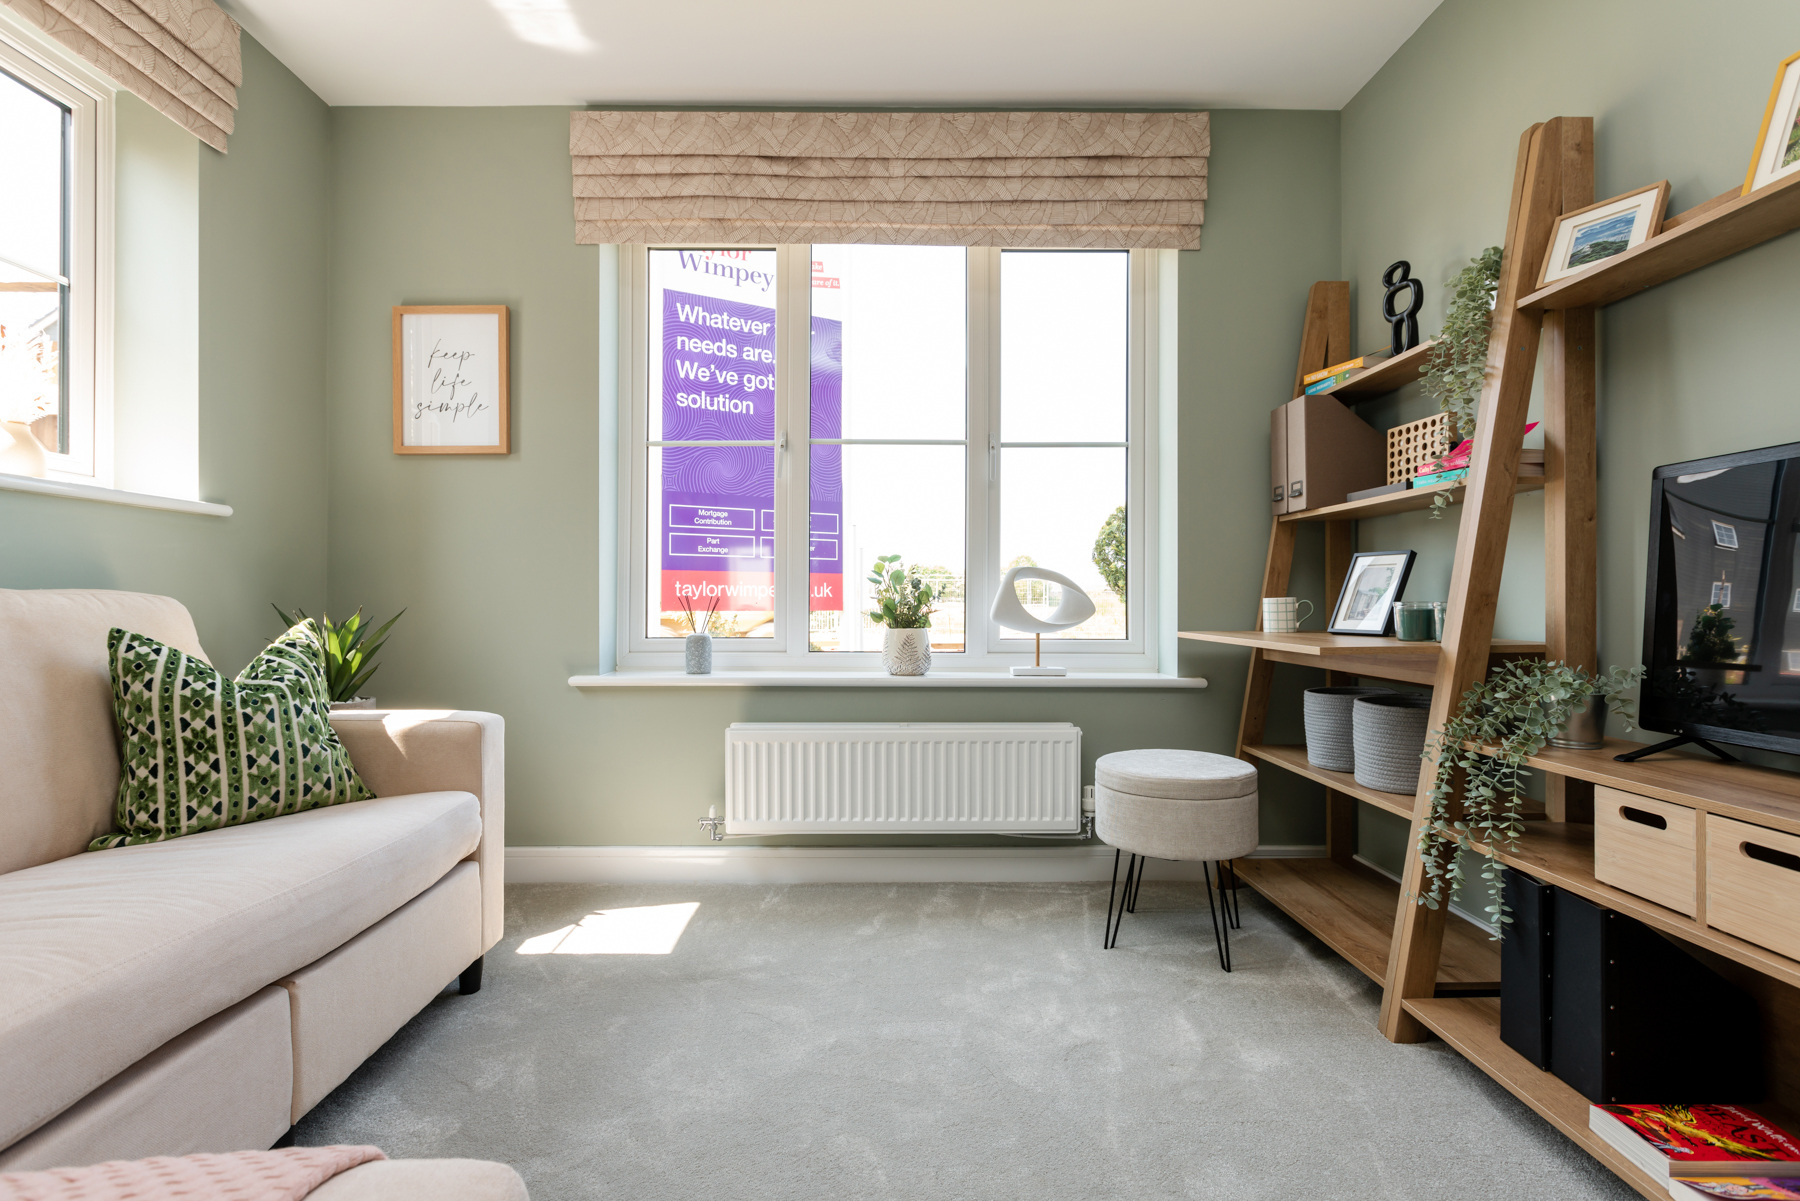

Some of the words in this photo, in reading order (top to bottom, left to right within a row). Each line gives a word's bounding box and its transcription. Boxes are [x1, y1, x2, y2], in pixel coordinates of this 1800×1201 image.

[678, 250, 775, 292] Wimpey
[676, 302, 771, 336] Whatever
[428, 338, 476, 371] keep
[676, 335, 738, 358] needs
[431, 367, 472, 401] life
[743, 373, 775, 392] got
[414, 392, 489, 423] simple
[676, 391, 754, 415] solution
[694, 517, 732, 526] Contribution
[698, 509, 728, 518] Mortgage
[698, 545, 729, 554] Exchange
[706, 537, 720, 545] Part
